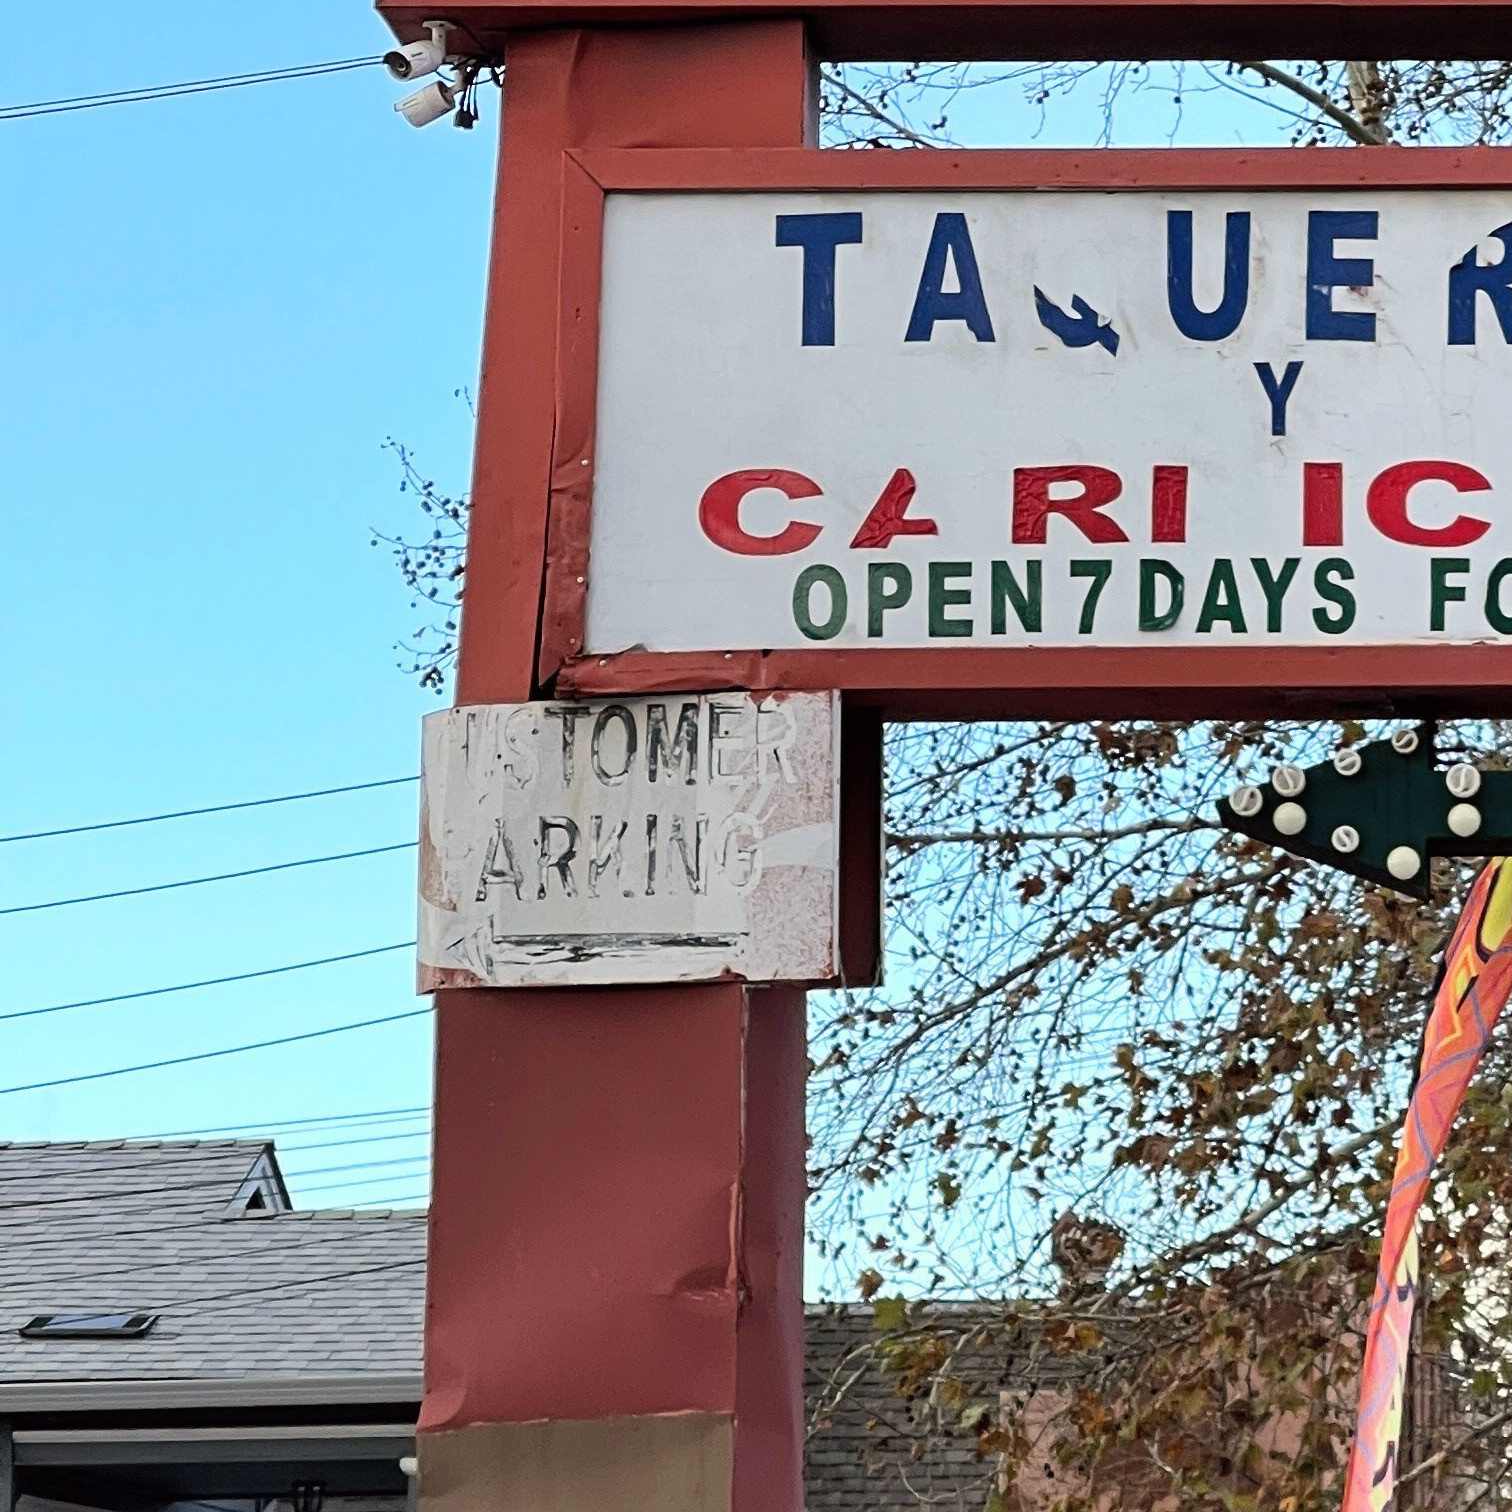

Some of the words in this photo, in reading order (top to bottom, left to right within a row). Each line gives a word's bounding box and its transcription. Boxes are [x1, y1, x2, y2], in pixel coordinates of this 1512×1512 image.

[1254, 360, 1304, 437] Y
[792, 558, 1043, 641] OPEN
[1138, 557, 1357, 635] DAYS
[443, 813, 764, 903] ARKING
